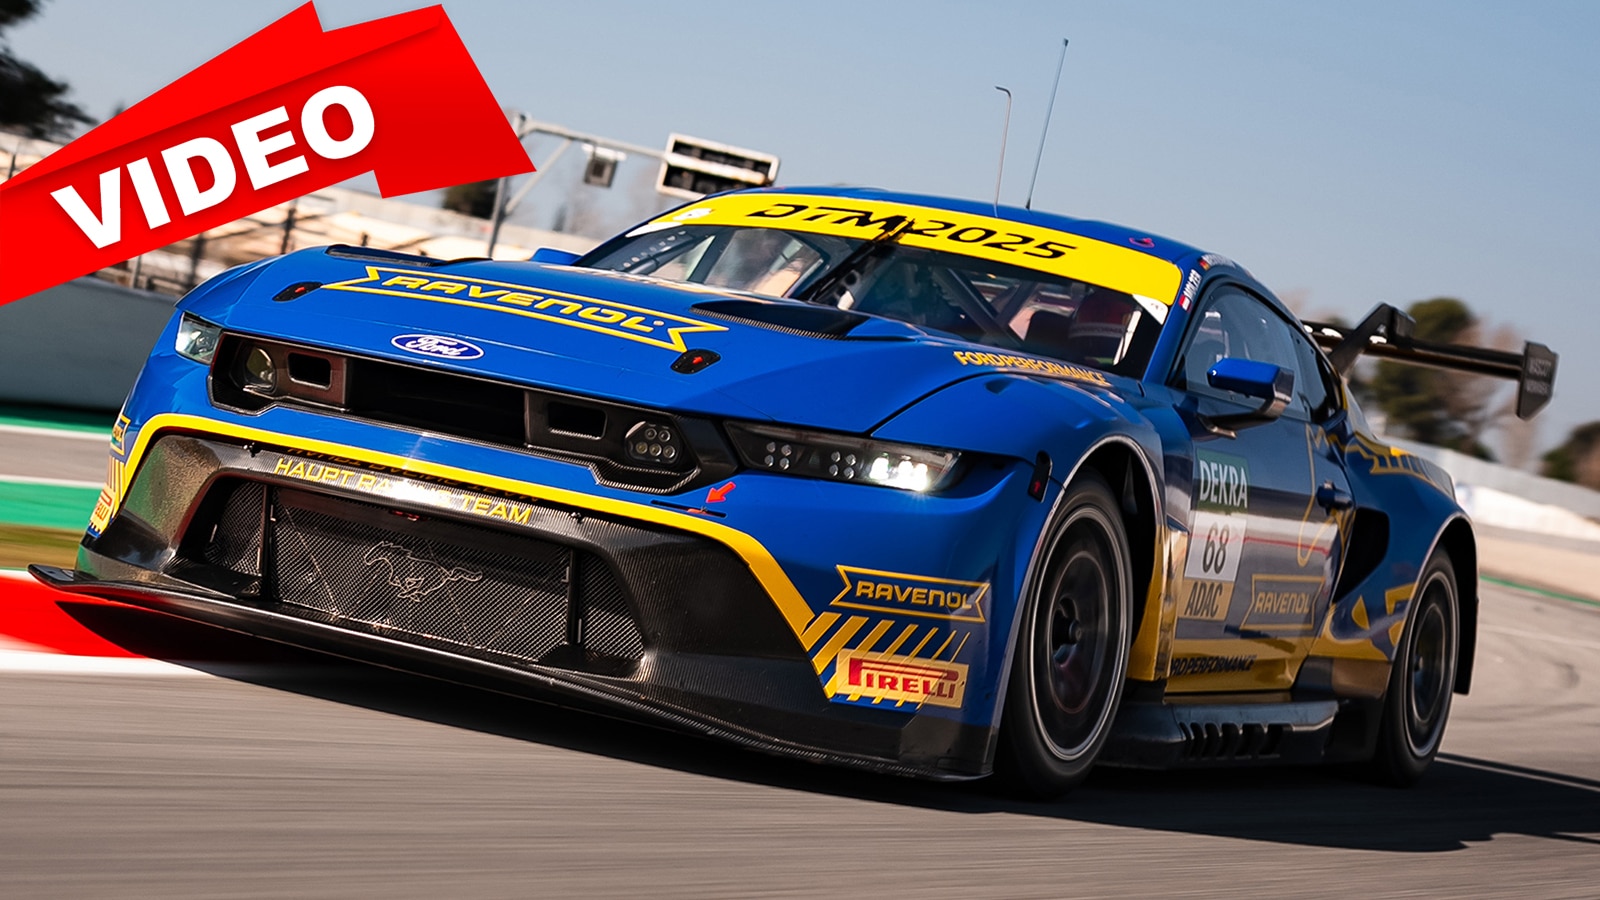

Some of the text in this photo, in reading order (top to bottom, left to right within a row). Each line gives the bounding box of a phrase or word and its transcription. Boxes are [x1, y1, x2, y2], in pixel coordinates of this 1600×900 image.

[746, 203, 1077, 259] DTM 2025
[382, 275, 654, 332] RAVENOL
[405, 336, 468, 356] Ford
[274, 458, 355, 488] HAUPT
[460, 494, 532, 524] TEAM
[1200, 460, 1248, 508] DEKRA
[1202, 522, 1230, 574] 68
[856, 580, 972, 609] RAVENOL
[1184, 581, 1223, 617] ADAC
[1254, 591, 1310, 614] RAVENOL
[848, 657, 959, 699] PIRELLI
